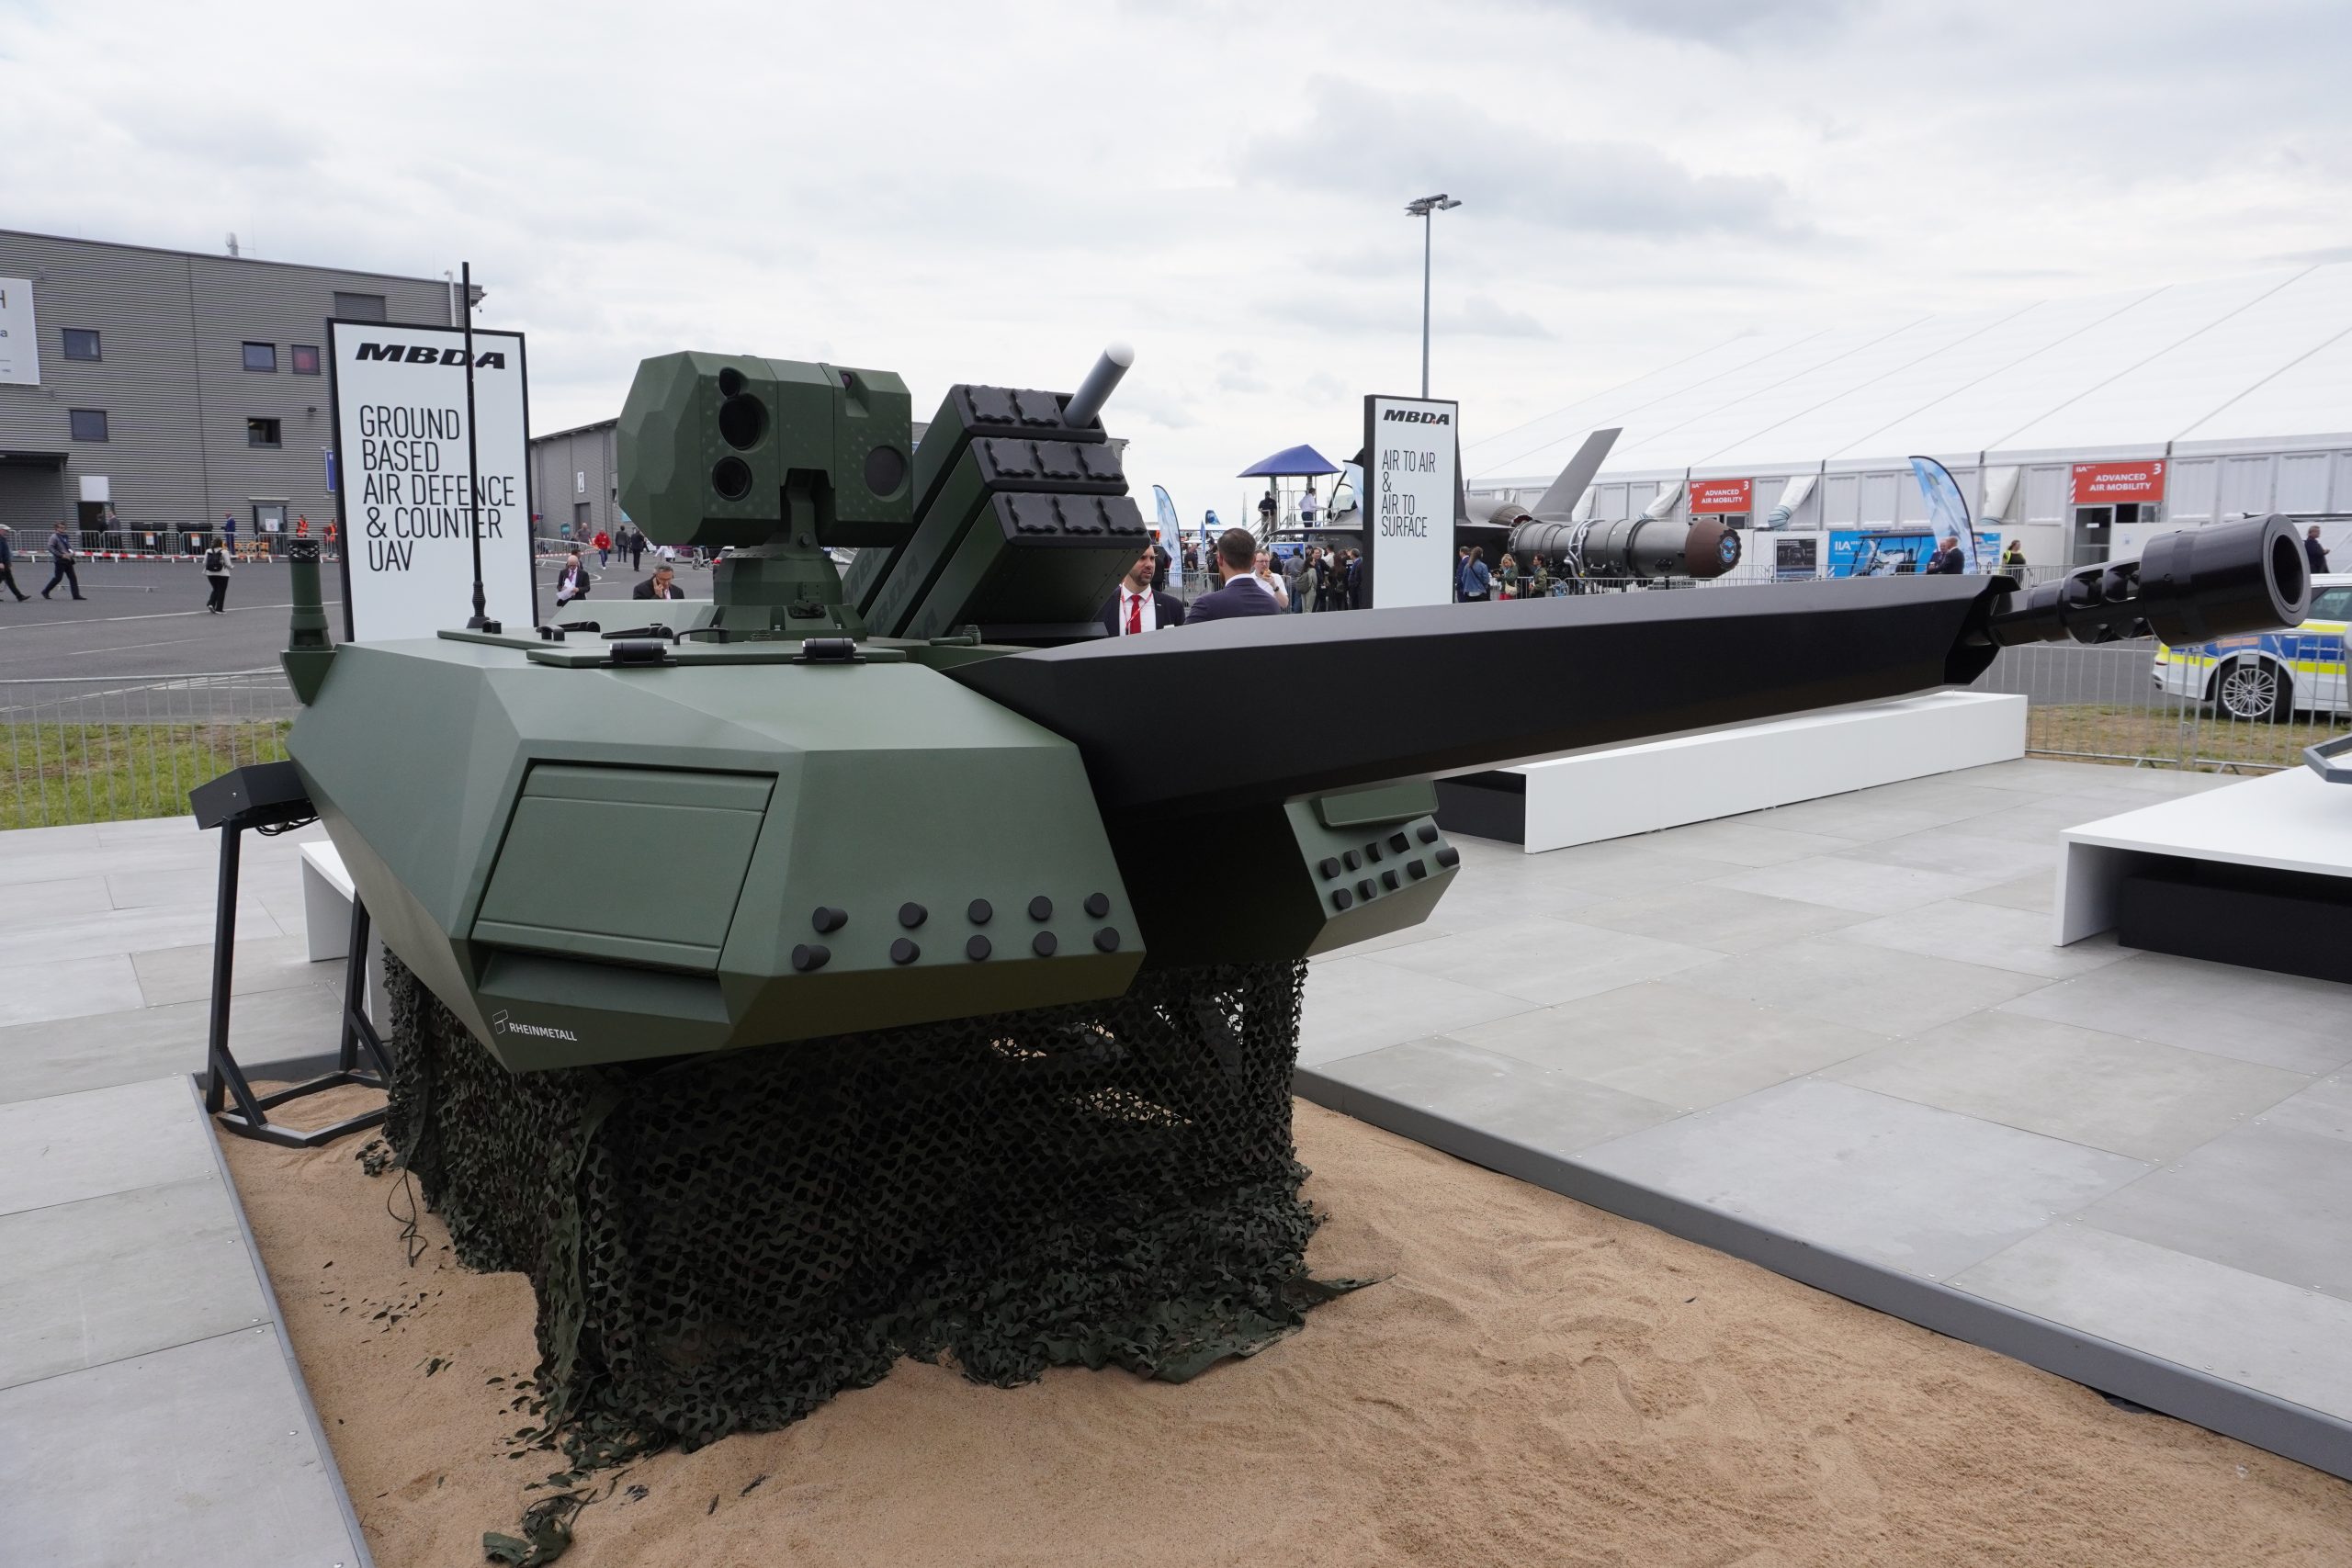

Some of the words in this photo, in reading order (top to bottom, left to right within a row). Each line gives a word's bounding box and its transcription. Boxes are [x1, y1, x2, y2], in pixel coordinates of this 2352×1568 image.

[356, 343, 505, 369] MBDA
[360, 404, 459, 440] GROUND
[1384, 410, 1450, 425] MBDA
[362, 439, 439, 472] BASED
[1382, 449, 1399, 470] AIR
[1403, 450, 1416, 472] TO
[1419, 451, 1436, 473] AIR
[2096, 473, 2147, 482] ADVANCED
[2153, 463, 2162, 475] 3
[363, 473, 402, 504] AIR
[412, 474, 515, 506] DEFENCE
[1382, 471, 1392, 492] &
[1743, 480, 1749, 491] 3
[2089, 483, 2105, 491] AIR
[2107, 482, 2152, 491] MOBILITY
[1381, 494, 1399, 514] AIR
[1402, 494, 1415, 515] TO
[1713, 496, 1744, 504] MOBILITY
[367, 506, 388, 538] &
[395, 507, 503, 538] COUNTER
[1381, 515, 1428, 537] SURFACE
[368, 540, 413, 571] UAV
[1835, 540, 1851, 551] ILA
[508, 1022, 578, 1041] RHEINMETALL
